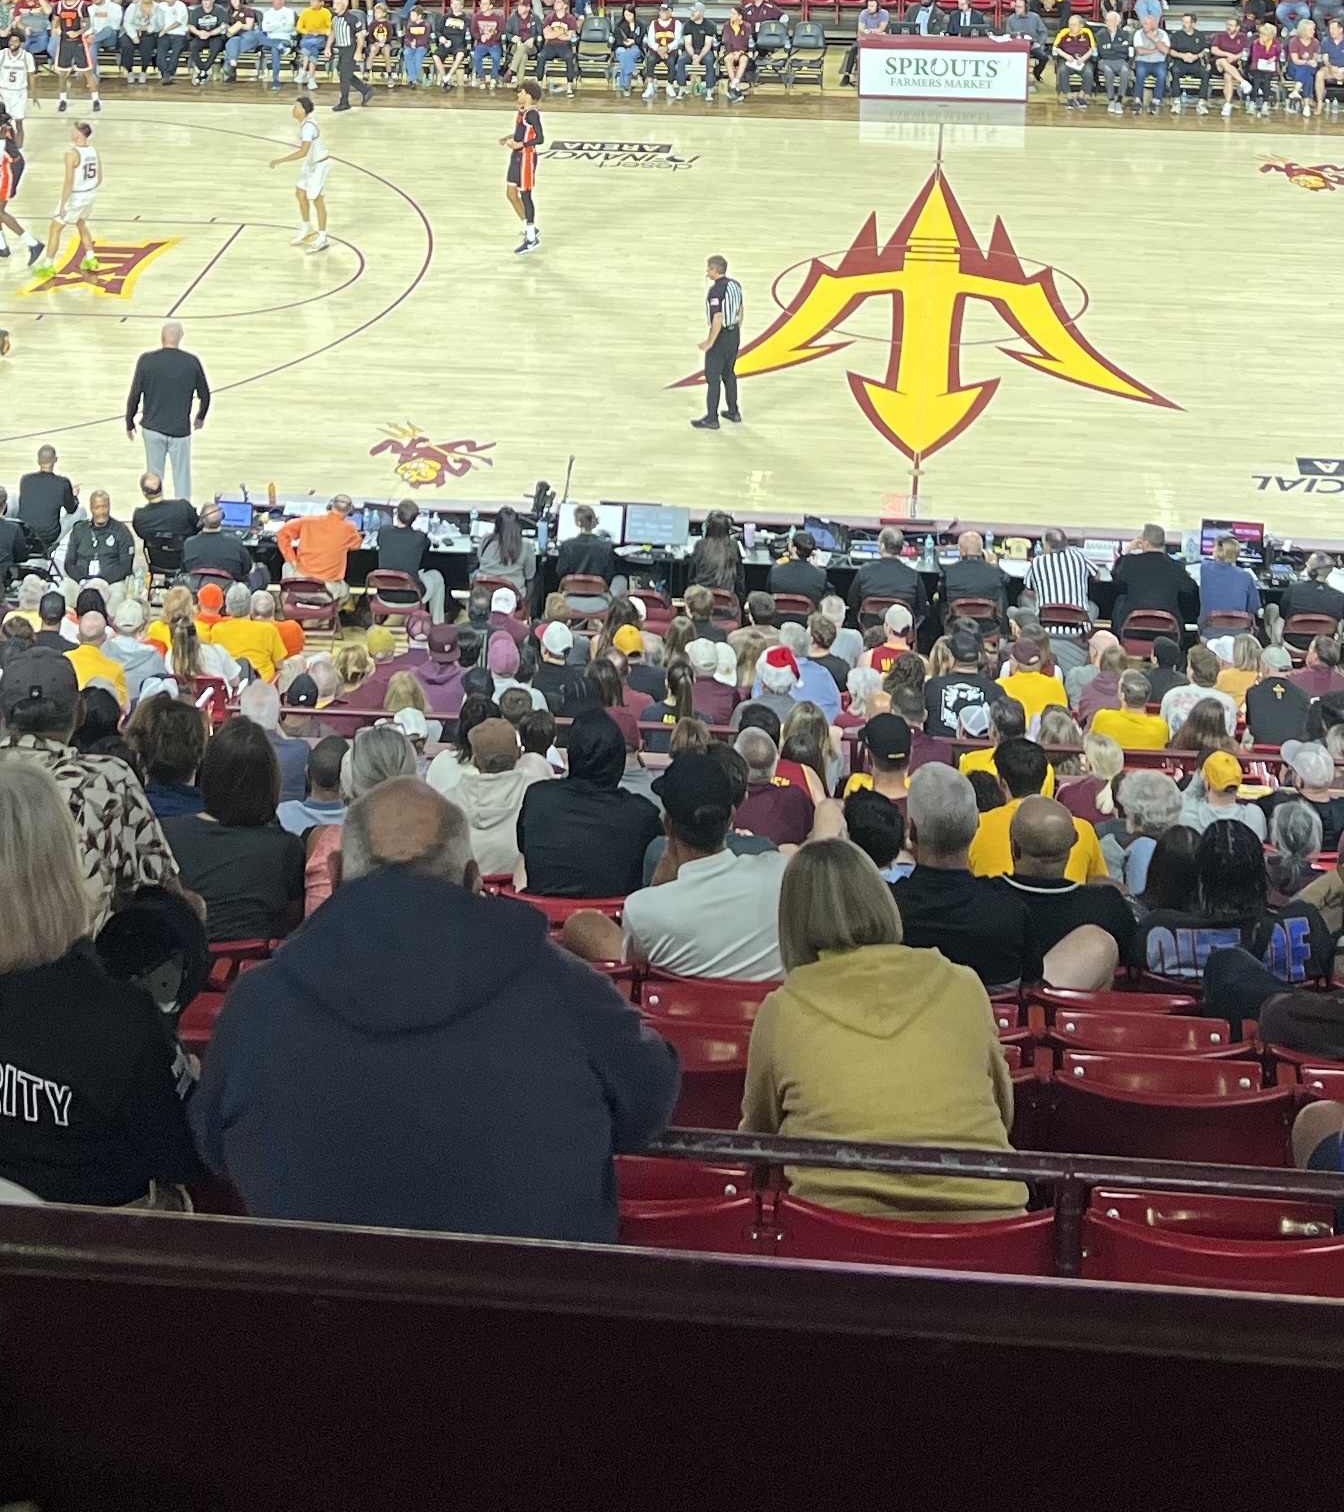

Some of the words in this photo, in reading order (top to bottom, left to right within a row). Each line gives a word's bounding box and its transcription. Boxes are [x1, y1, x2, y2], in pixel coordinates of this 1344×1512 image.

[885, 56, 998, 78] SPROUTS
[890, 77, 942, 88] FARMERS
[944, 78, 993, 90] MARKET
[563, 142, 661, 152] ARENA
[82, 163, 97, 179] 15
